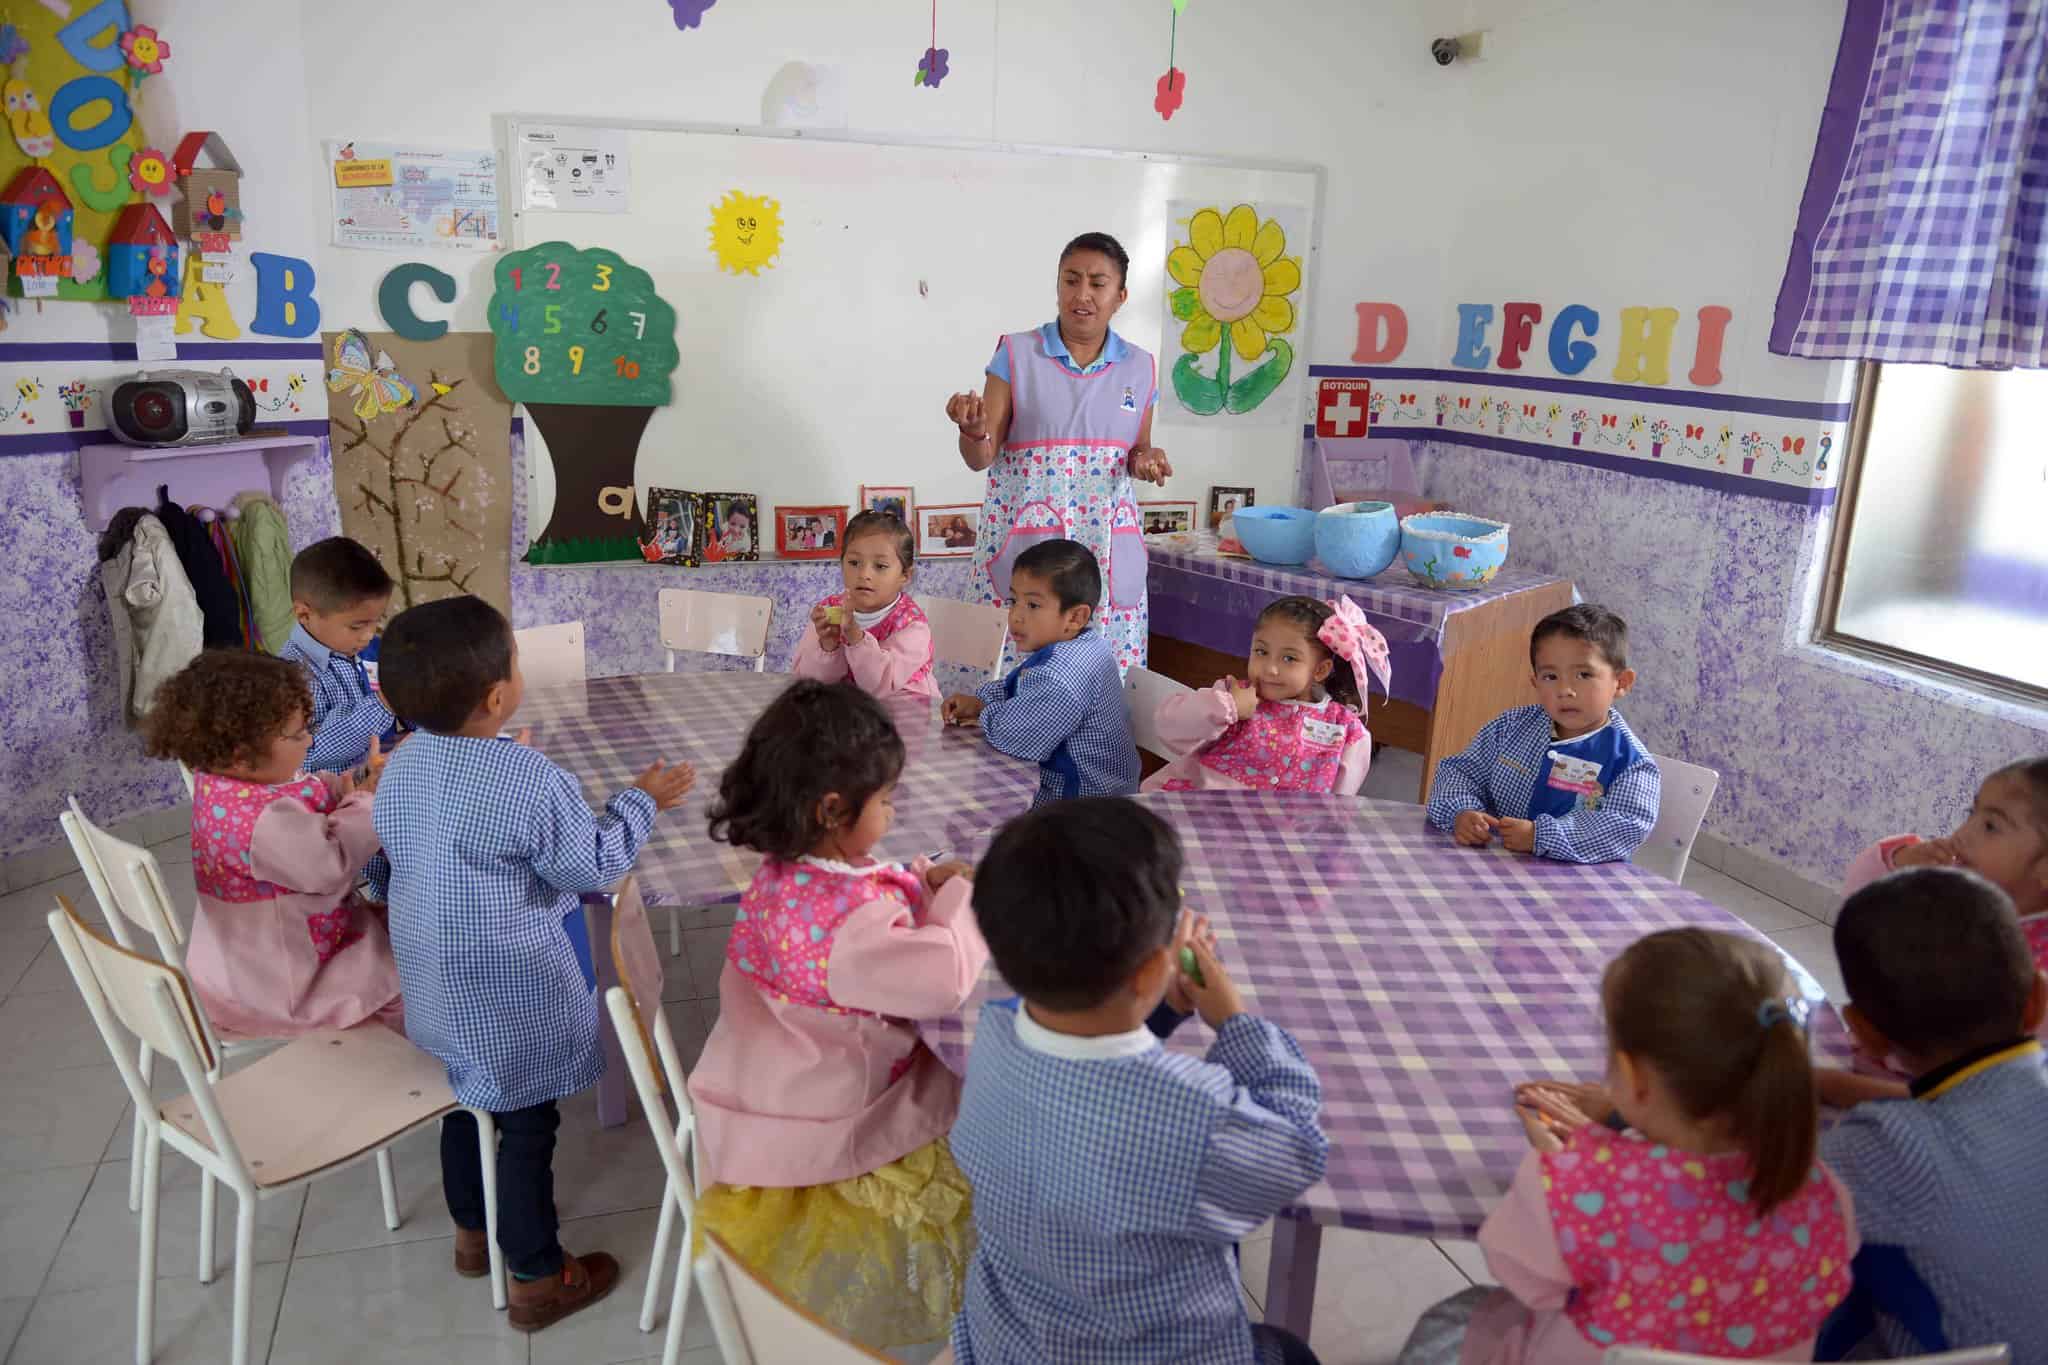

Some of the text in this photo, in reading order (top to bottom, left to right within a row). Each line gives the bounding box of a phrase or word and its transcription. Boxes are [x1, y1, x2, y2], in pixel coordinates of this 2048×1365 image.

[509, 263, 613, 292] 1 2 3
[250, 252, 321, 338] B
[378, 262, 456, 341] C
[501, 304, 646, 340] 4 5 6 7
[1351, 302, 1408, 364] D
[523, 346, 640, 379] 8 9 10
[1322, 381, 1368, 391] BOTIQUIN
